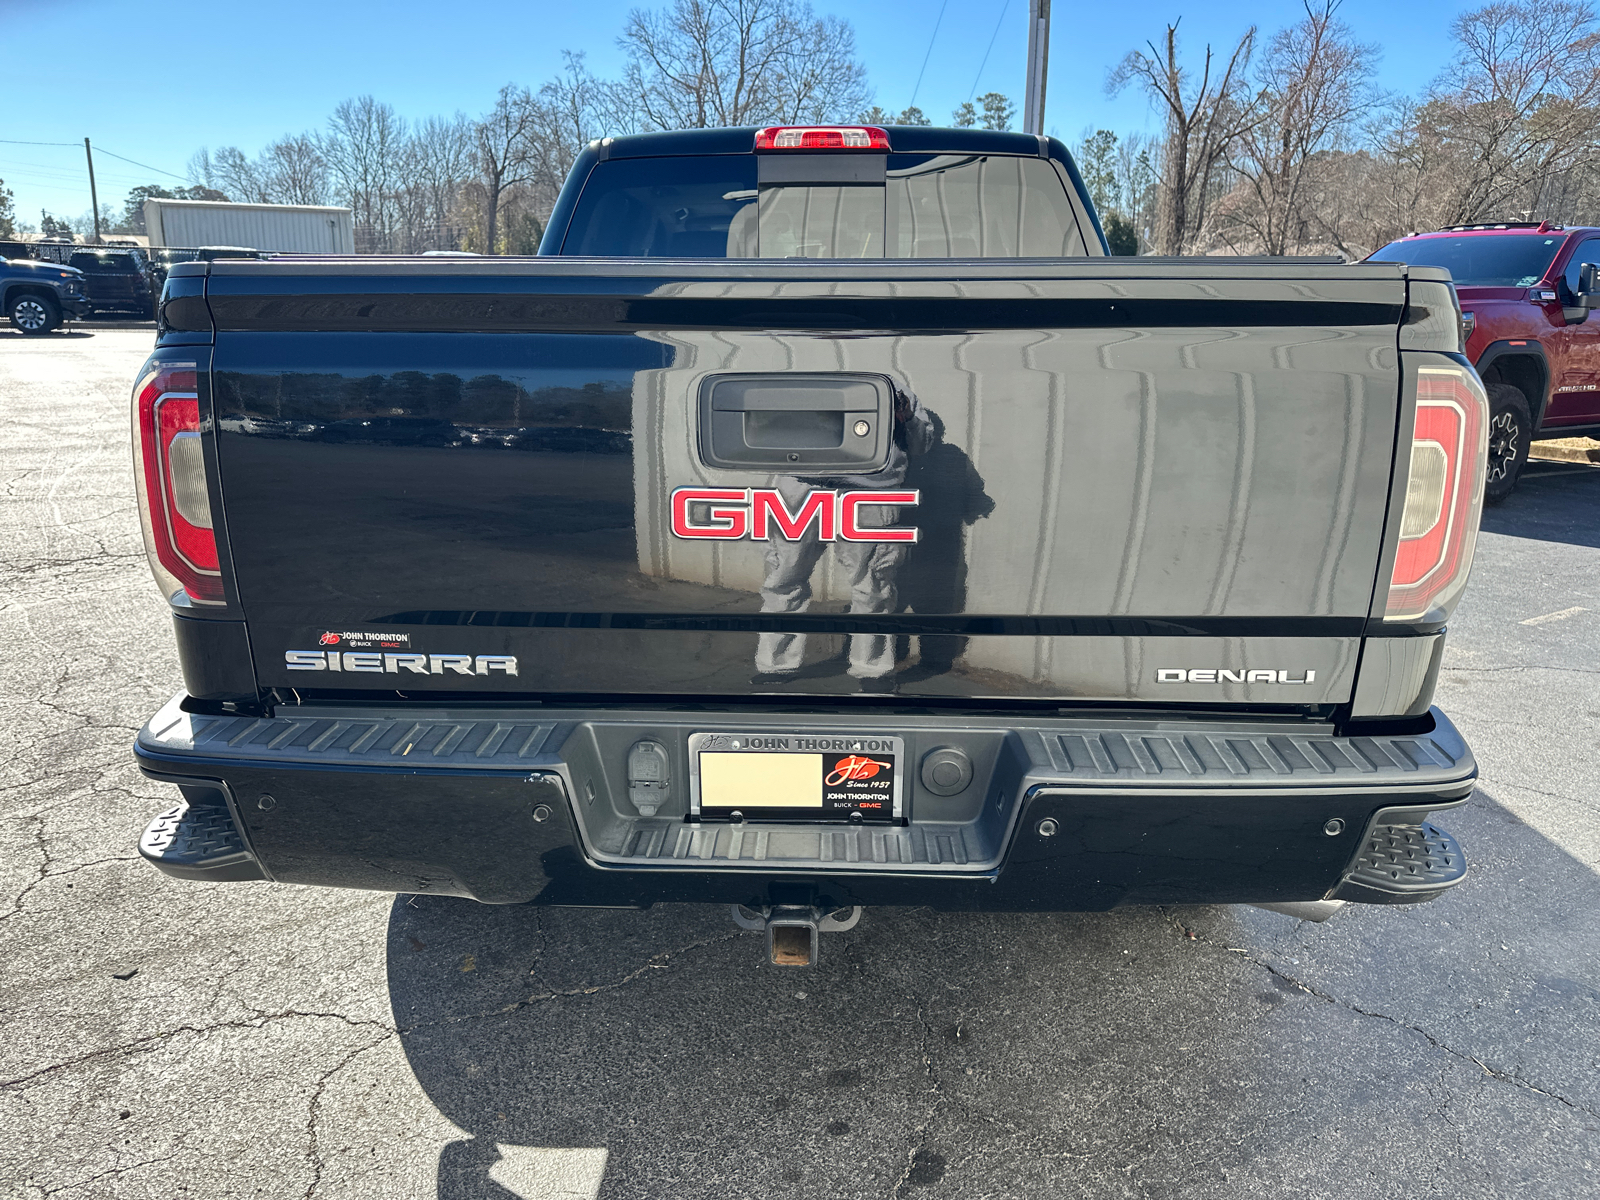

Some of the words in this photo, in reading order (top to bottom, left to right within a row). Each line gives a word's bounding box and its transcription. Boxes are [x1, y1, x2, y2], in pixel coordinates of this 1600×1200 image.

[670, 485, 920, 543] GMC
[342, 632, 363, 640] JOHN
[364, 632, 408, 642] THORNTON
[285, 650, 519, 676] SIERRA
[1156, 668, 1316, 685] DENALI
[742, 738, 789, 750] JOHN
[794, 739, 894, 752] THORNTON
[846, 780, 869, 788] Since
[869, 781, 891, 789] 1957
[847, 793, 890, 801] THORNTON
